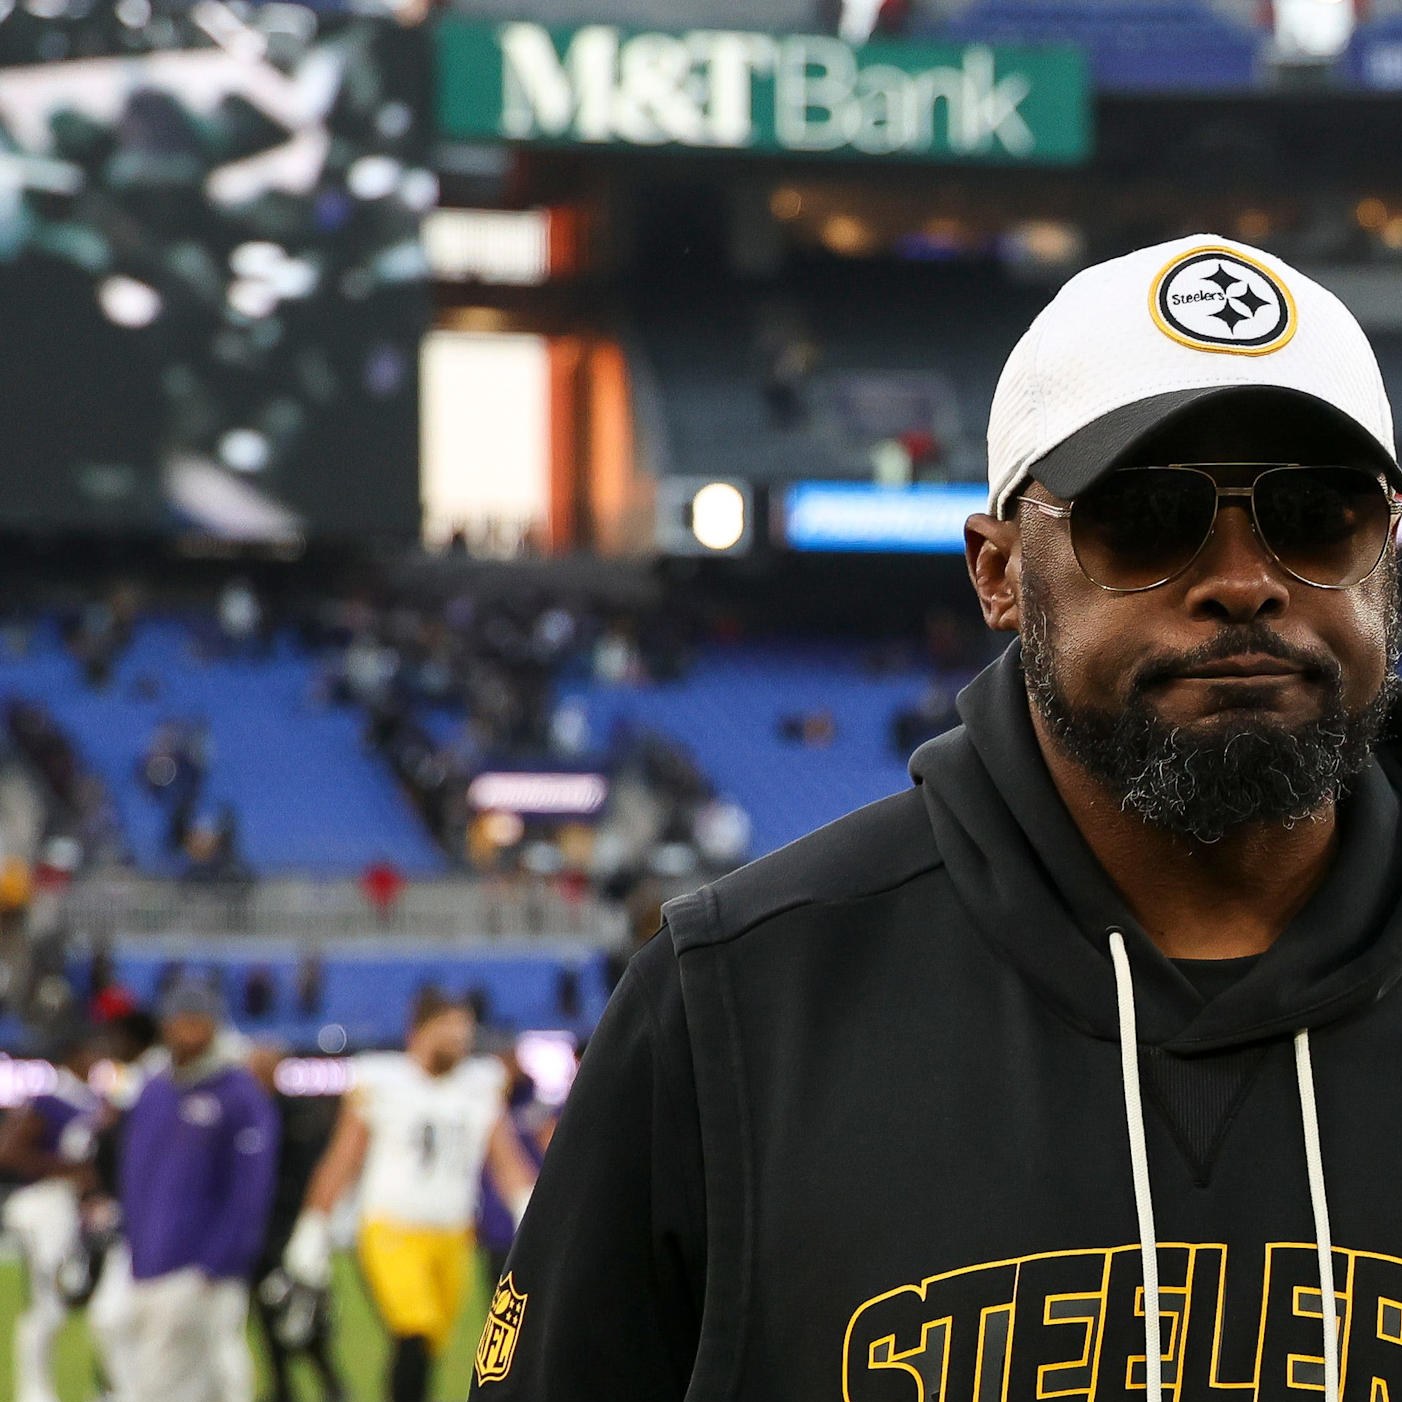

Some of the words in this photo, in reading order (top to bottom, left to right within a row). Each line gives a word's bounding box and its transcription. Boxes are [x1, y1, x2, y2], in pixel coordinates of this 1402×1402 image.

[497, 20, 777, 148] M&T
[774, 33, 1036, 157] Bank
[1171, 290, 1226, 306] Steelers
[481, 1319, 509, 1370] FL
